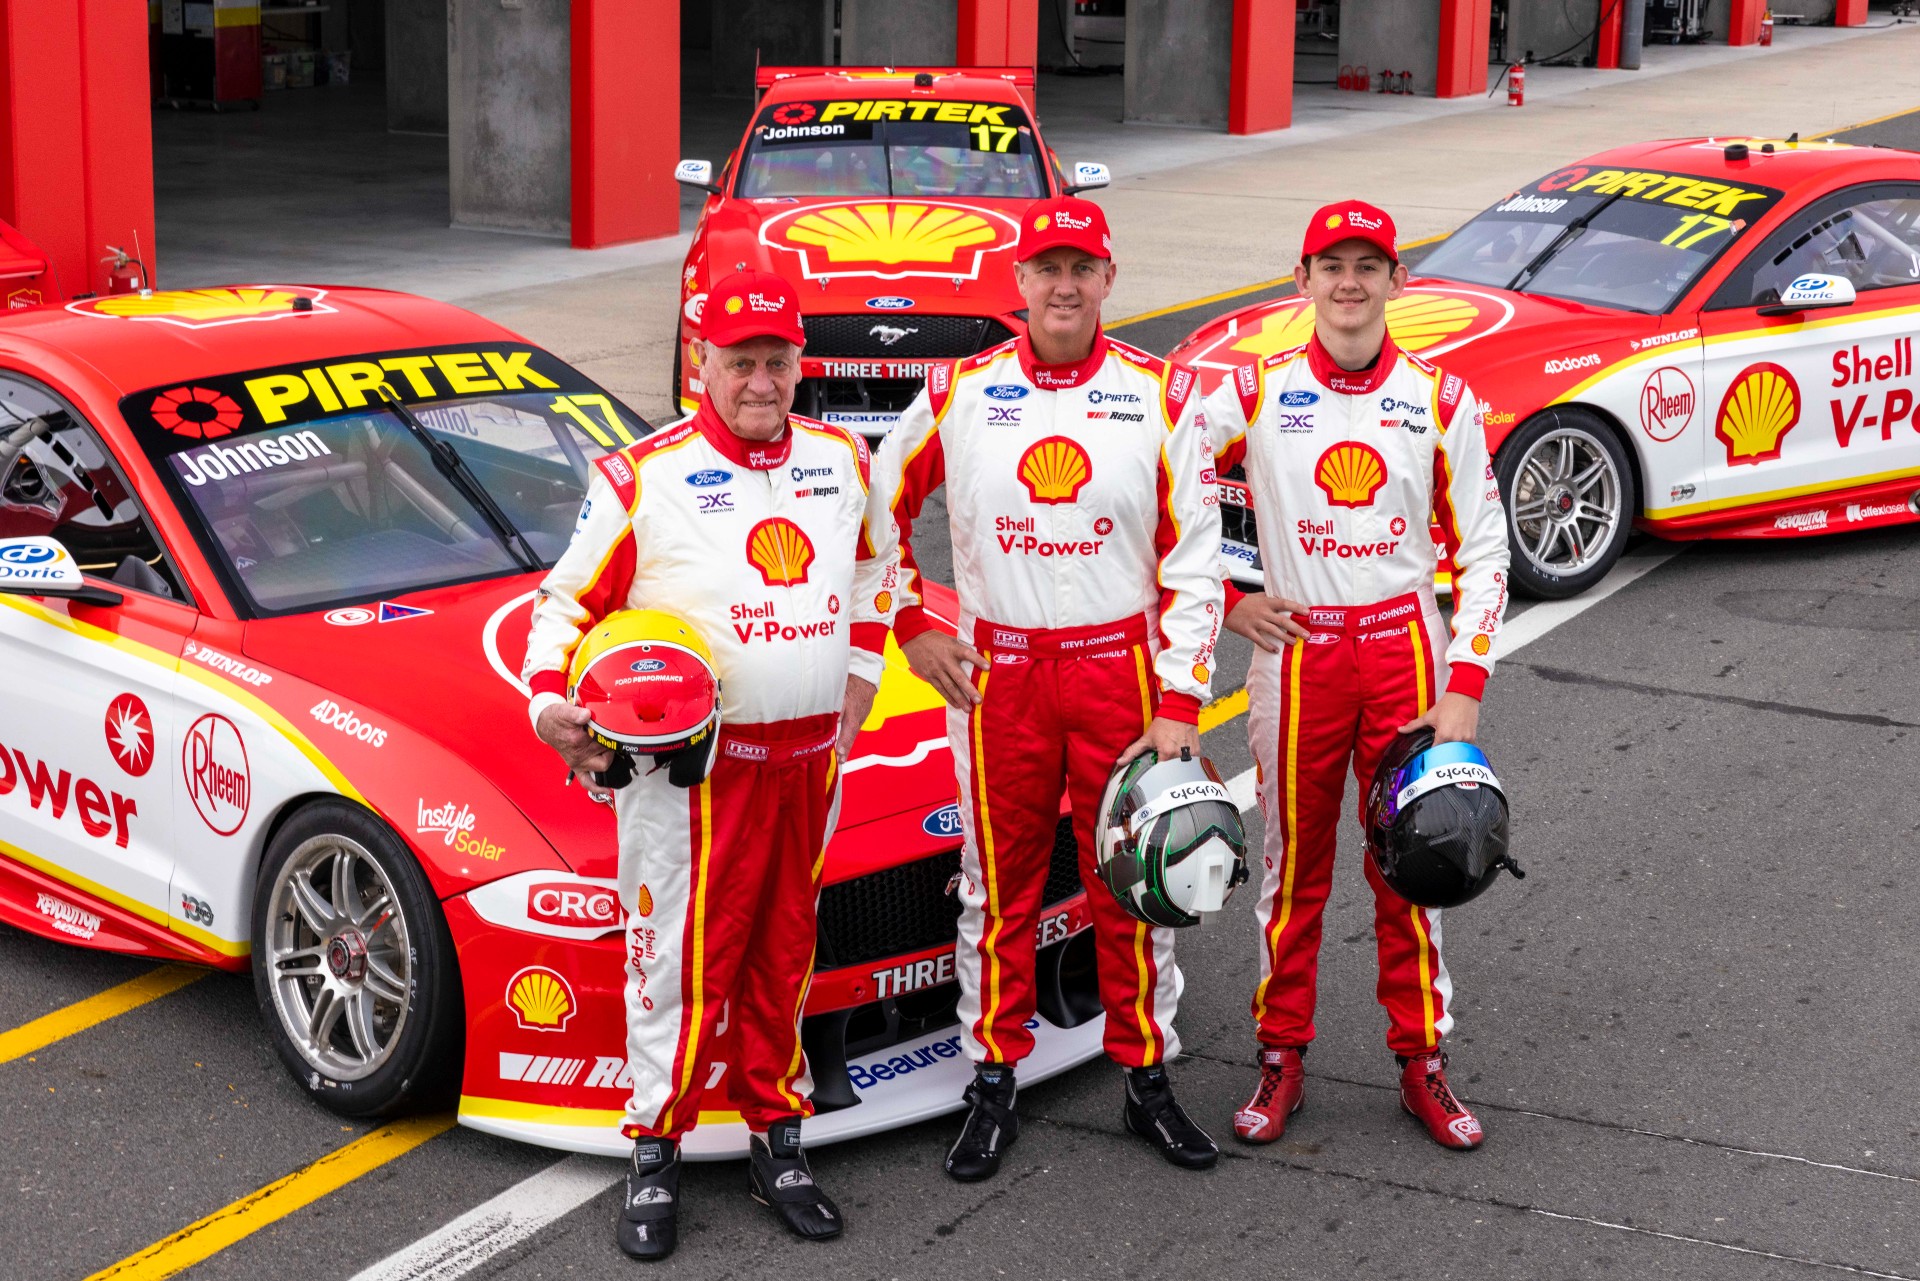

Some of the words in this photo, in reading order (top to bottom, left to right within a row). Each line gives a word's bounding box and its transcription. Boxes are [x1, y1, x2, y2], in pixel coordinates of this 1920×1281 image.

[819, 100, 1011, 126] PIRTEK
[763, 123, 845, 141] Johnson
[970, 124, 1017, 153] 17
[1569, 170, 1767, 216] PIRTEK
[1497, 193, 1568, 214] Johnson
[1660, 212, 1733, 250] 17
[875, 298, 905, 307] Ford
[1641, 328, 1699, 348] DUNLOP
[822, 361, 882, 378] THREE
[1543, 352, 1601, 375] 4Ddoors
[1831, 337, 1912, 388] Shell
[245, 352, 559, 425] PIRTEK
[1036, 376, 1076, 386] V-Power
[1330, 383, 1368, 392] V-Power
[992, 386, 1021, 398] Ford
[1283, 391, 1311, 404] Ford
[1646, 372, 1691, 431] Rheem
[549, 394, 635, 447] 17
[987, 407, 1022, 421] DXC
[1109, 411, 1145, 423] Repco
[1280, 414, 1314, 428] DXC
[1484, 411, 1516, 426] Solar
[177, 429, 332, 488] Johnson
[749, 451, 765, 459] Shell
[694, 470, 723, 485] Ford
[804, 467, 833, 478] PIRTEK
[696, 492, 734, 509] DXC
[812, 486, 840, 497] Repco
[995, 516, 1035, 532] Shell
[1297, 518, 1334, 536] Shell
[1774, 509, 1829, 530] REVOLUTION
[996, 535, 1103, 557] V-Power
[1298, 536, 1399, 559] V-Power
[881, 565, 892, 589] Shell
[730, 601, 775, 620] Shell
[1312, 611, 1345, 622] rpm
[1358, 614, 1376, 627] JETT
[1376, 603, 1415, 622] JOHNSON
[1478, 608, 1492, 631] Shell
[733, 619, 836, 645] V-Power
[996, 631, 1027, 643] rpm
[1060, 639, 1084, 649] STEVE
[1085, 631, 1126, 648] JOHNSON
[1370, 626, 1408, 641] FORMULA
[1192, 642, 1207, 663] Shell
[194, 646, 273, 687] DUNLOP
[637, 660, 660, 670] Ford
[615, 677, 632, 686] FORD
[632, 674, 684, 684] PERFORMANCE
[309, 699, 389, 749] 4Ddoors
[597, 734, 617, 750] Shell
[690, 728, 708, 746] Shell
[622, 744, 639, 753] FORD
[639, 741, 686, 753] PERFORMANCE
[729, 742, 767, 756] rpm
[191, 717, 247, 813] Rheem
[1435, 765, 1490, 781] Kubota
[1169, 785, 1224, 800] Kubota
[417, 797, 476, 846] Instyle
[454, 831, 506, 862] Solar
[36, 892, 105, 933] REVOLUTION
[532, 888, 615, 920] CRC
[644, 928, 656, 960] Shell
[872, 952, 956, 999] THRE
